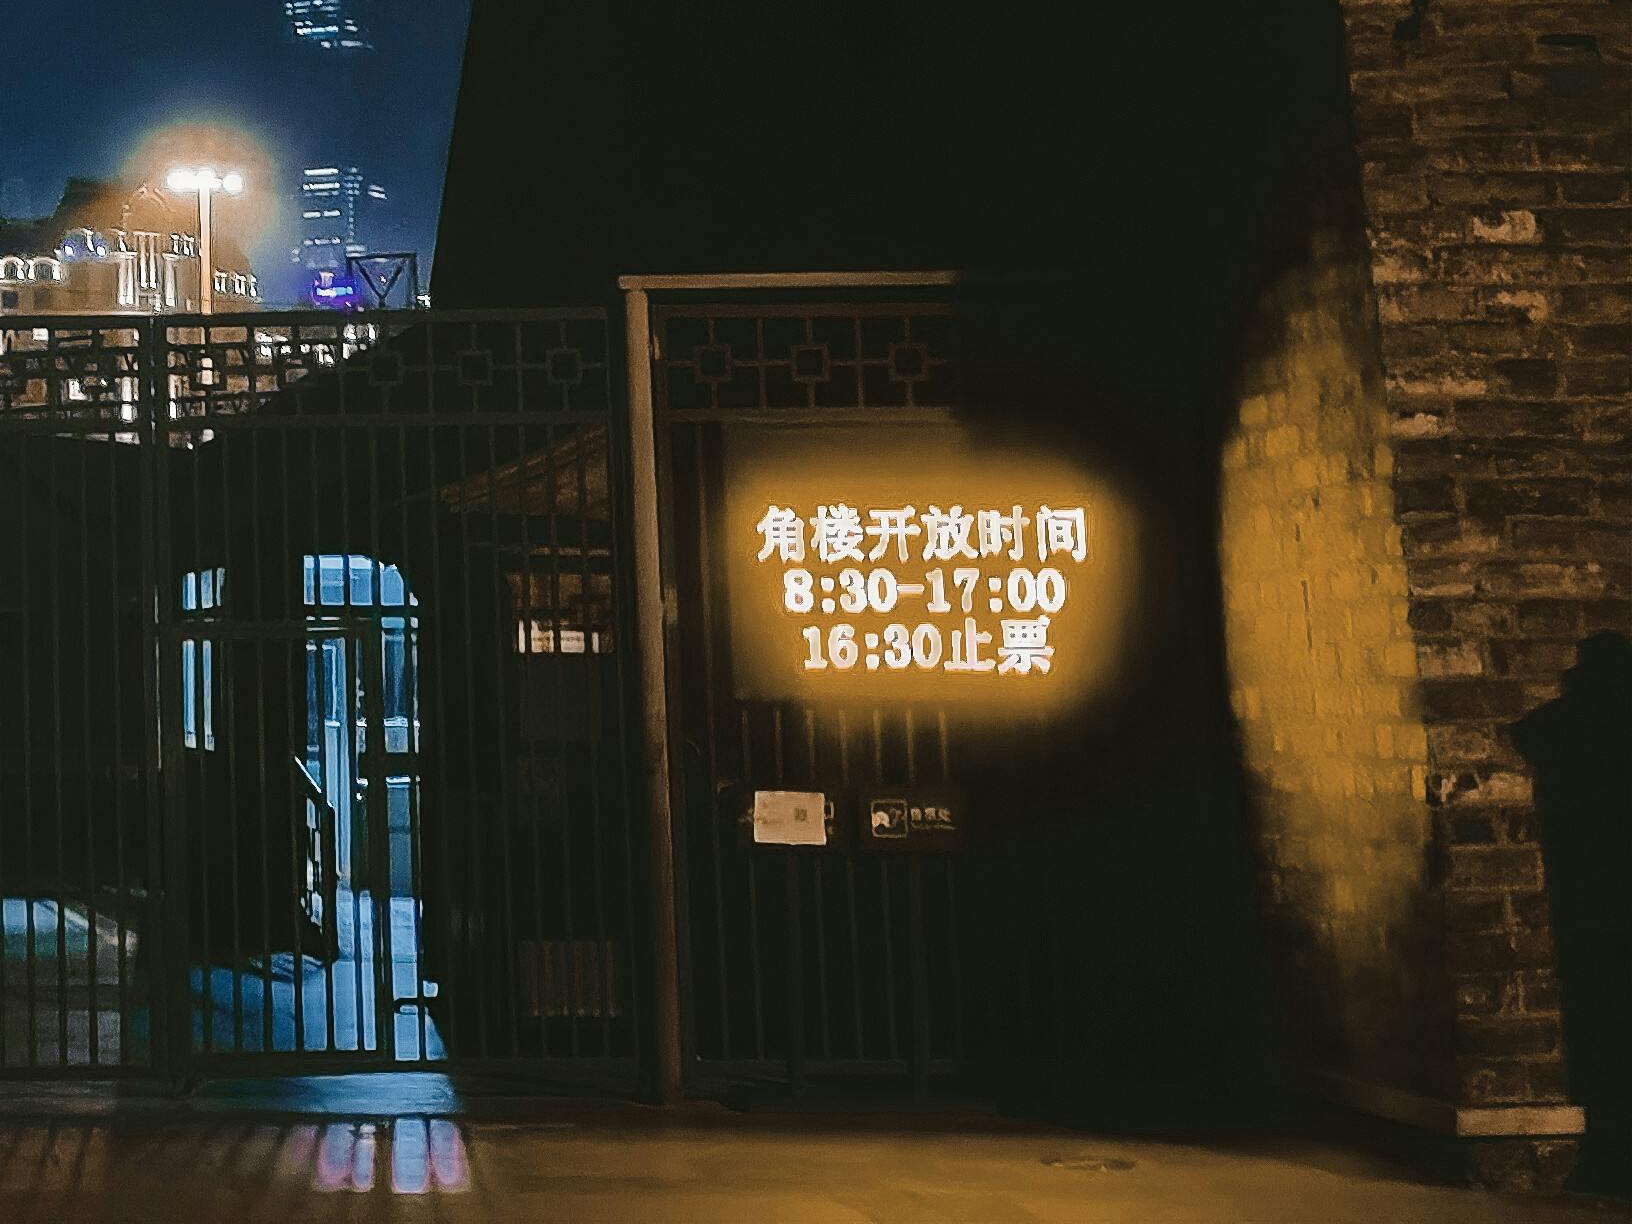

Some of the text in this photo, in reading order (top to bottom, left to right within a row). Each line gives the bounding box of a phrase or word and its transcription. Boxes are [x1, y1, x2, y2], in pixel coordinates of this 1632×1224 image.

[756, 503, 1088, 564] 角楼开放时间
[783, 567, 1067, 614] 8:30-17:00
[802, 615, 1055, 675] 16:30止票
